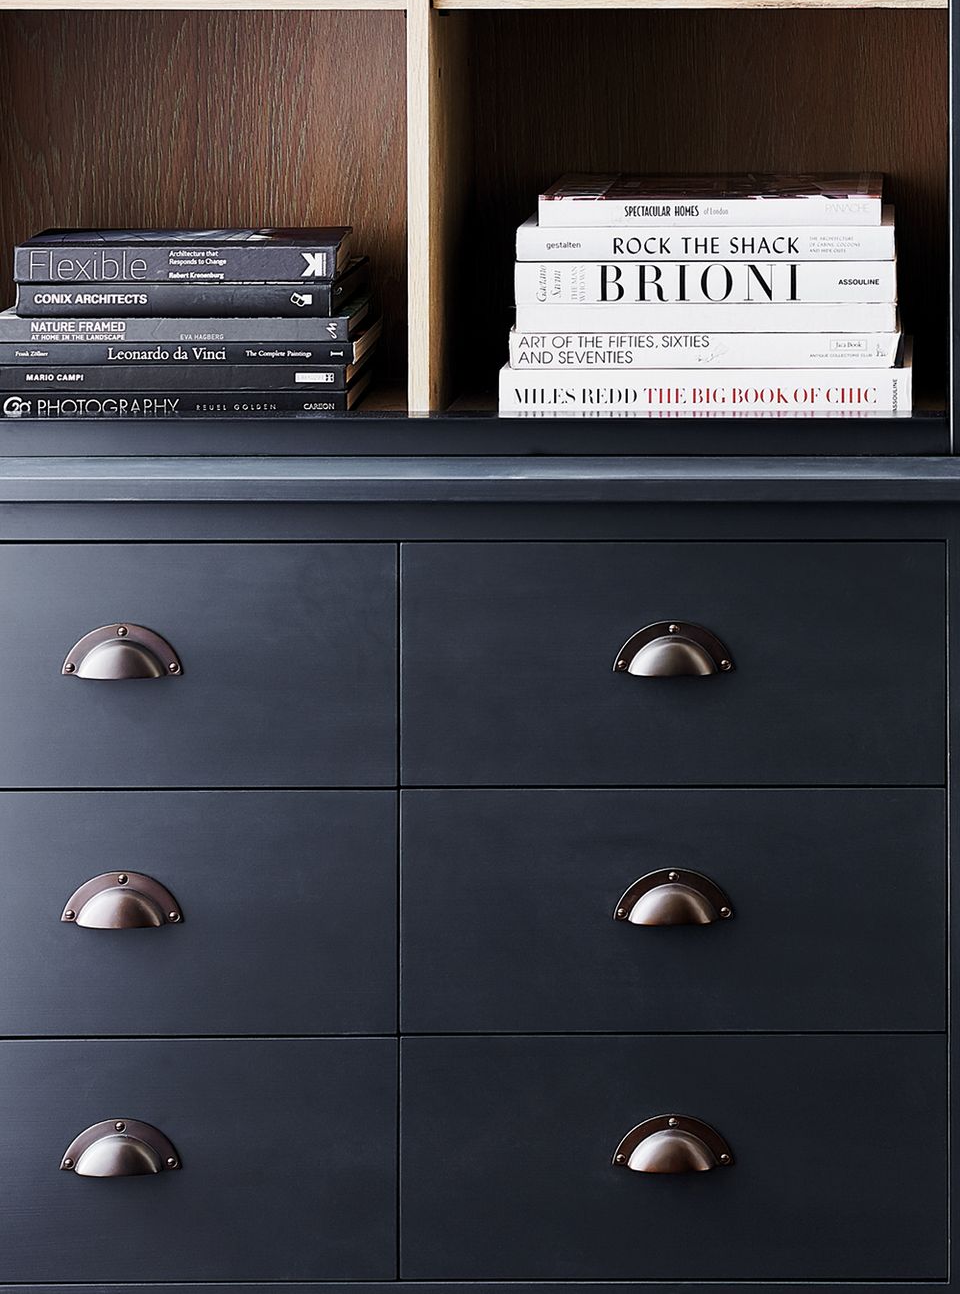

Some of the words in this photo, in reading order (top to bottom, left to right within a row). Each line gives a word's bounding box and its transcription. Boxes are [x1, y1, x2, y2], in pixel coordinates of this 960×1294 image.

[624, 205, 671, 217] SPECTACULAR
[674, 205, 700, 217] HOMES
[710, 208, 729, 216] London
[825, 203, 870, 214] PANACHE
[546, 241, 582, 250] gestalten
[613, 237, 672, 255] ROCK
[681, 237, 720, 255] THE
[730, 236, 800, 255] SHACK
[28, 250, 148, 281] Flexible
[169, 258, 198, 266] Responds
[205, 258, 227, 266] Change
[596, 263, 801, 303] BRIONI
[838, 278, 880, 286] ASSOULINE
[34, 293, 72, 305] CONIX
[75, 293, 148, 305] ARCHITECTS
[30, 322, 76, 332] NATURE
[78, 322, 126, 332] FRAMED
[518, 336, 547, 349] ART
[551, 336, 573, 349] OF
[578, 336, 603, 349] THE
[661, 335, 710, 348] SIXTIES
[107, 347, 169, 360] Leonardo
[173, 346, 189, 360] da
[192, 347, 227, 360] Vinci
[258, 350, 286, 358] Complete
[518, 351, 554, 364] AND
[558, 351, 634, 364] SEVENTIES
[26, 374, 55, 382] MARIO
[56, 374, 85, 382] CAMPI
[514, 388, 576, 404] MILES
[582, 388, 638, 404] REDD
[643, 388, 687, 404] THE
[692, 388, 726, 404] BIG
[732, 387, 789, 404] BOOK
[793, 387, 821, 404] OF
[826, 387, 877, 404] CHIC
[234, 403, 277, 411] GOLDEN
